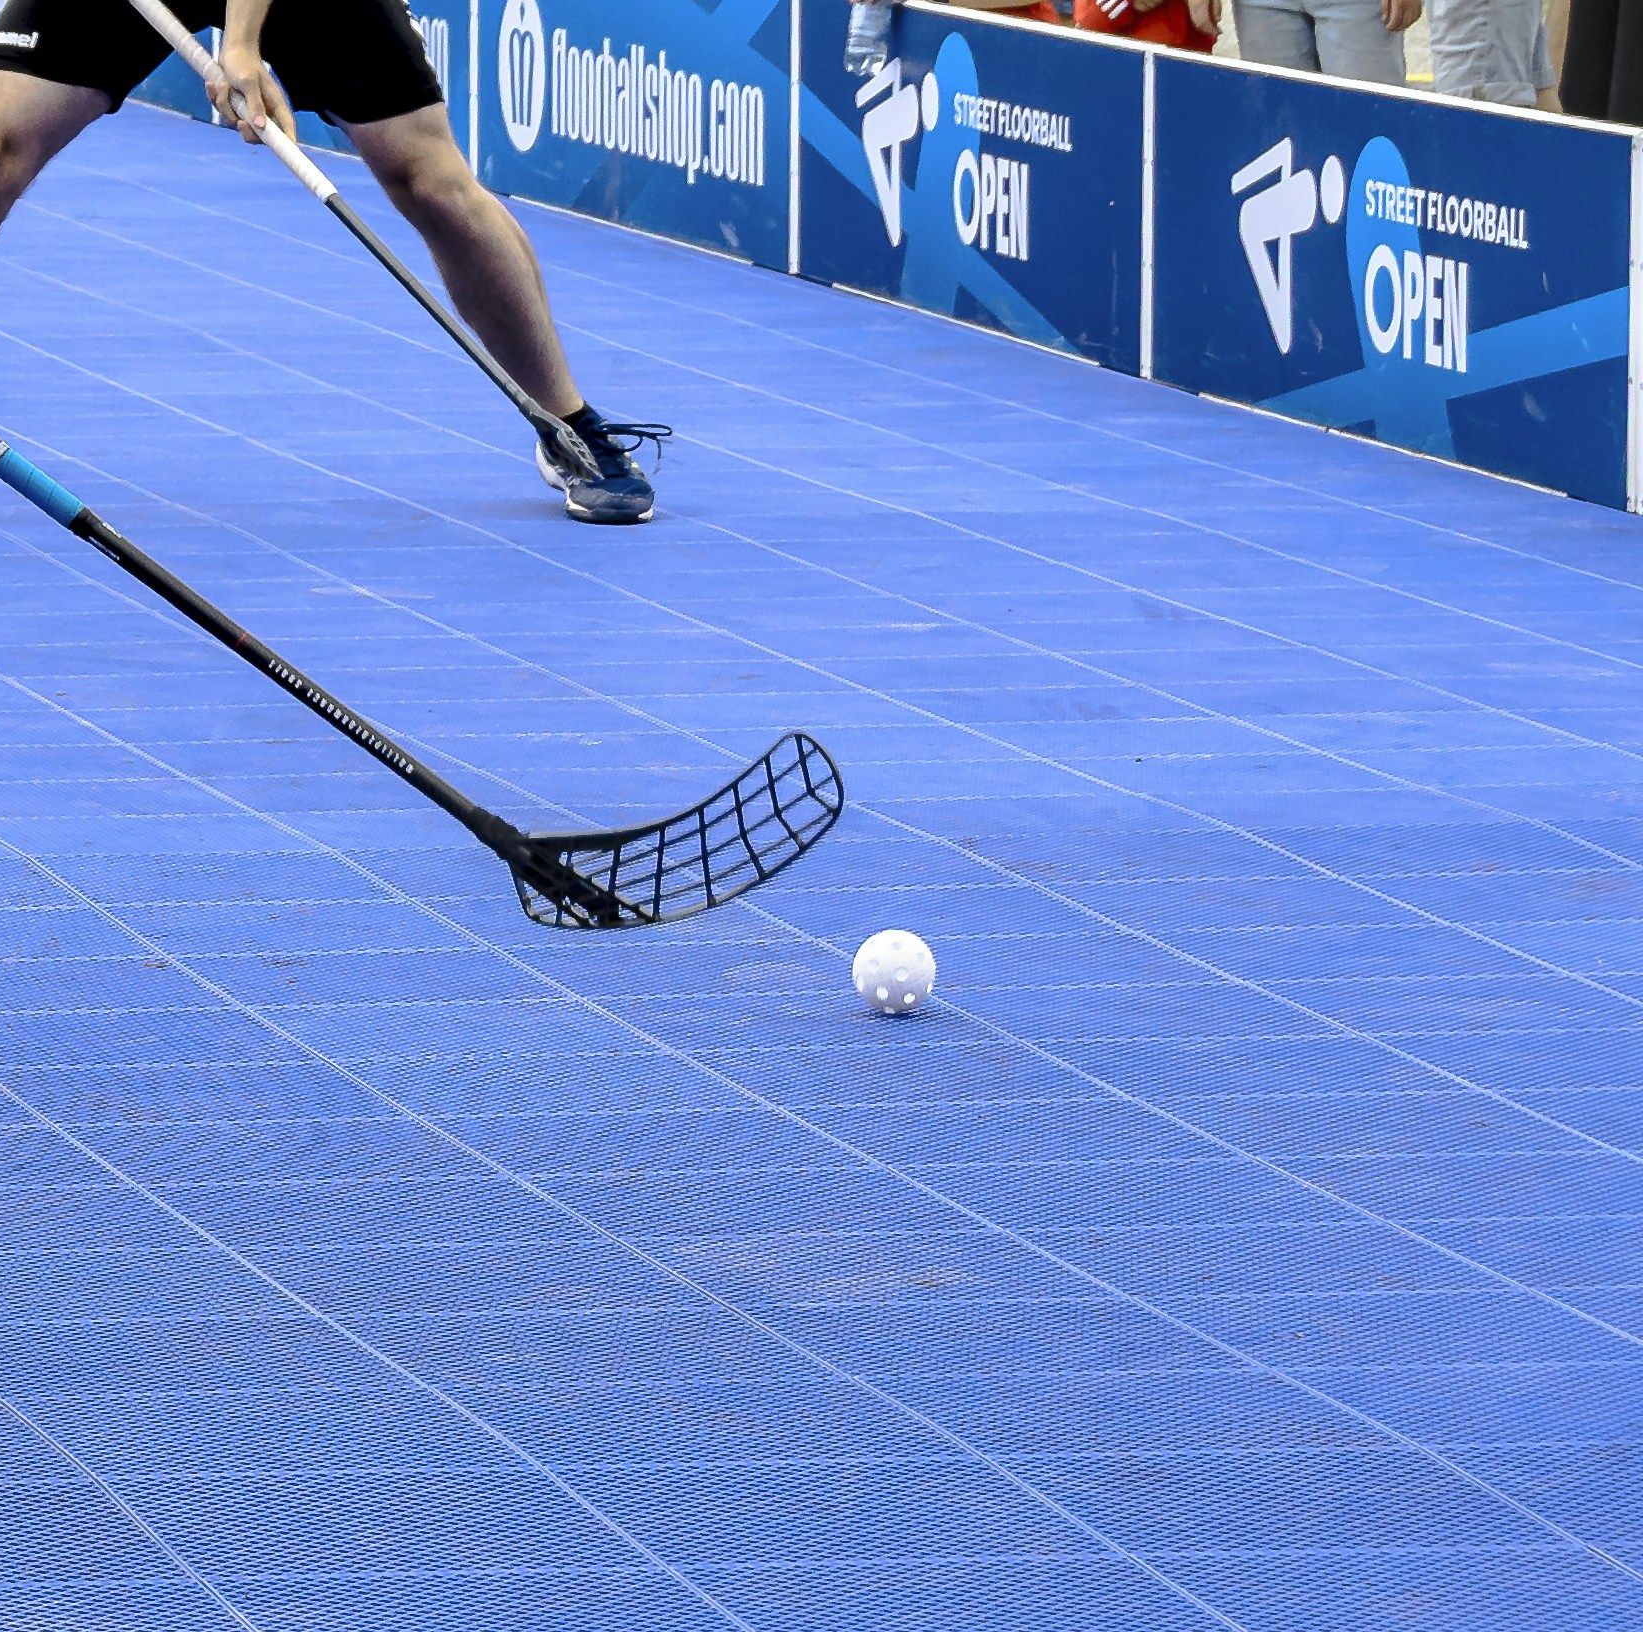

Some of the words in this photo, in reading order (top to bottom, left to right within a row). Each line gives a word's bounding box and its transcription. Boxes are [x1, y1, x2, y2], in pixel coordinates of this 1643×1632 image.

[550, 27, 767, 188] floorballshop.com
[954, 92, 998, 134] STREET
[998, 101, 1073, 153] FLOORBALL
[953, 149, 1030, 262] OPEN
[1365, 179, 1426, 227] STREET
[1427, 191, 1530, 250] FLOORBALL
[1364, 244, 1469, 374] OPEN
